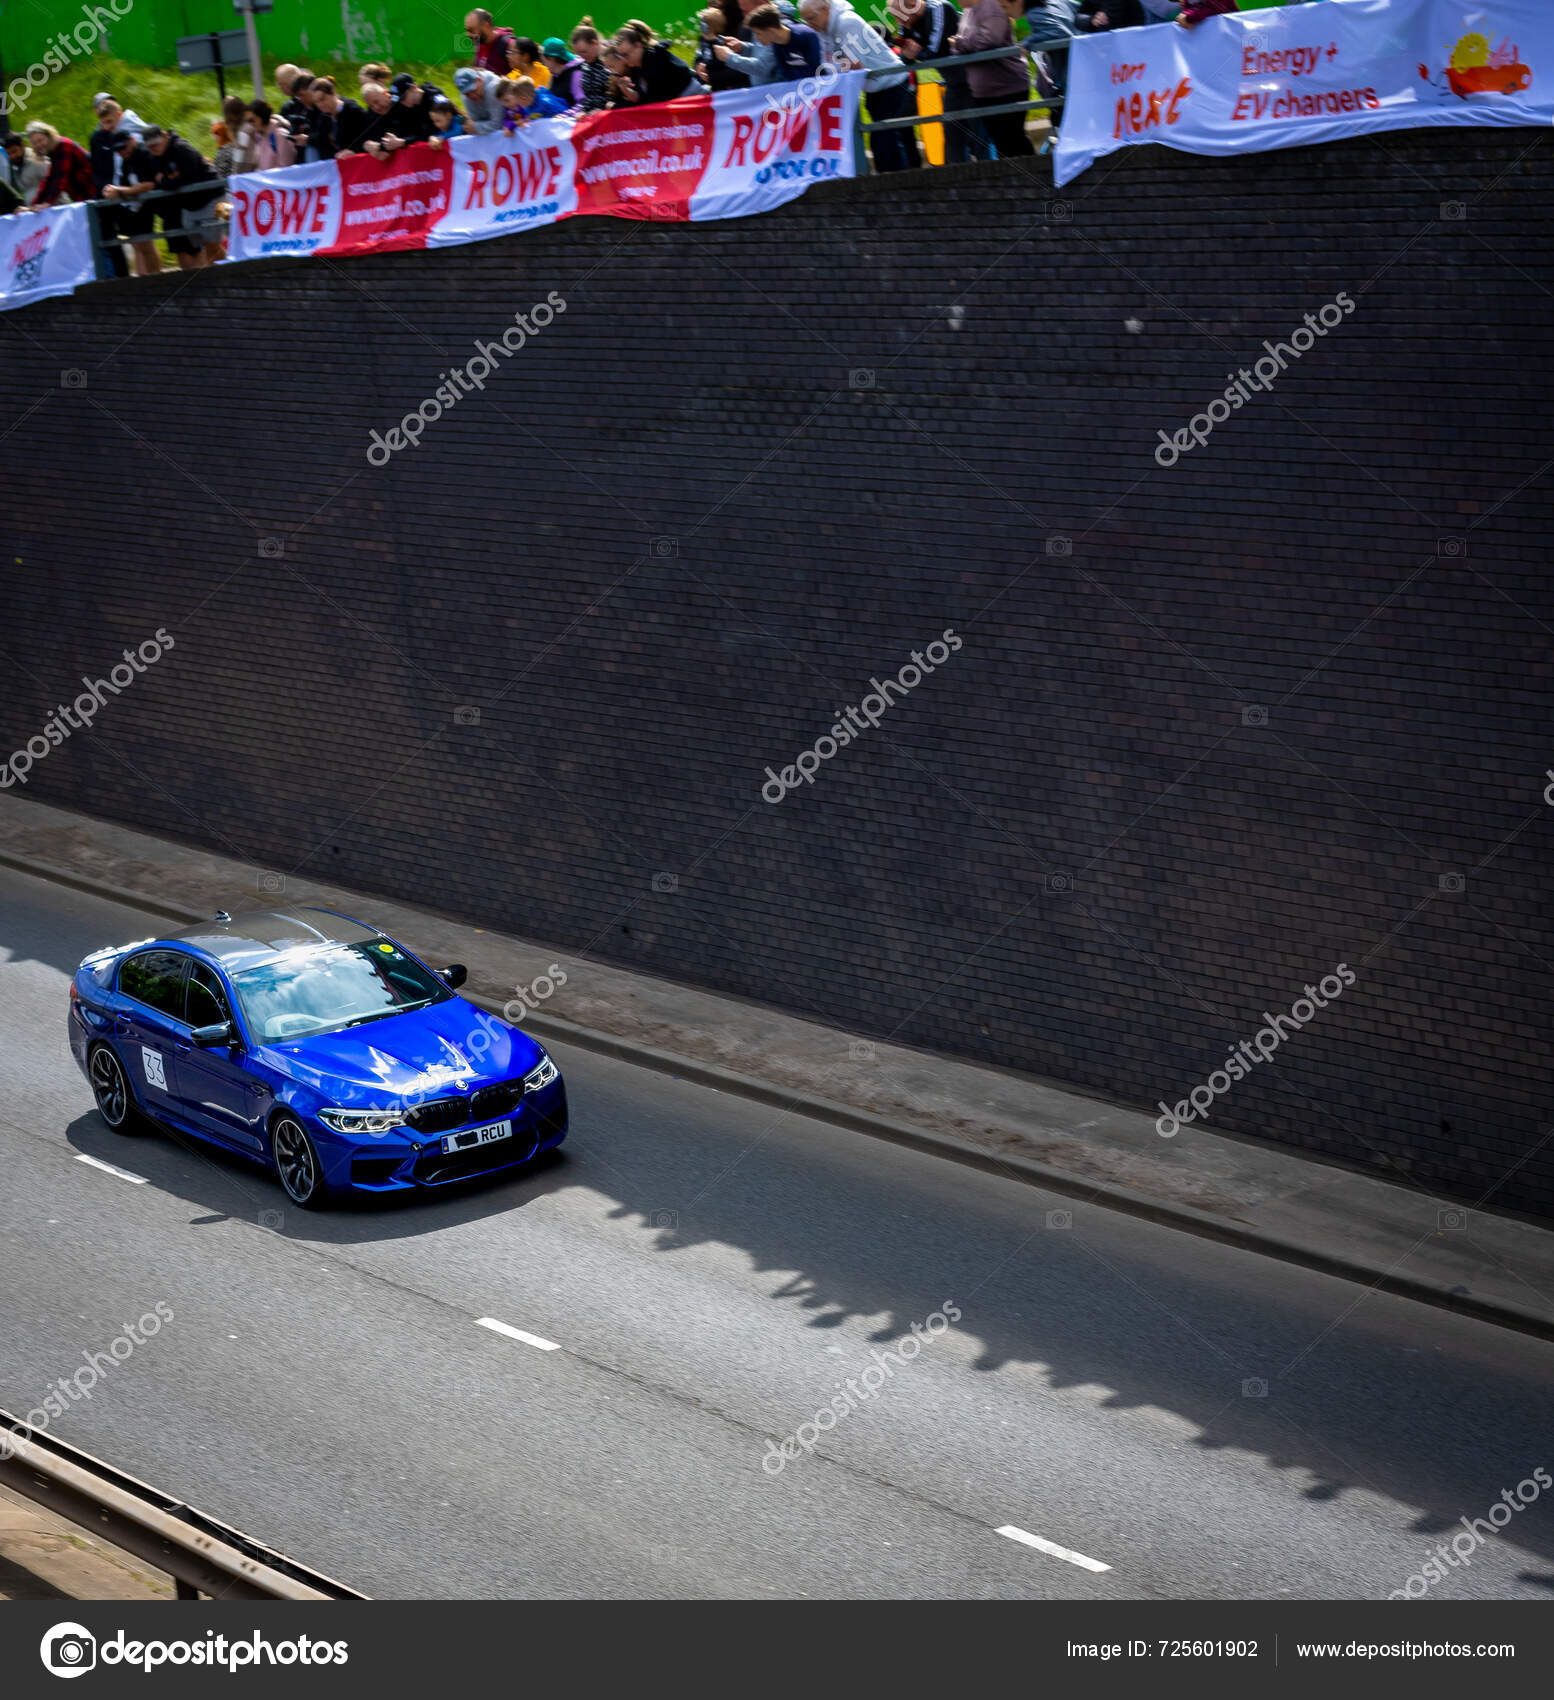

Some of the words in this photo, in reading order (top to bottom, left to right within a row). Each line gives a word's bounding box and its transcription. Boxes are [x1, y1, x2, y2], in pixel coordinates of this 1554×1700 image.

[1241, 46, 1322, 76] Energy
[1111, 77, 1193, 139] next
[1231, 92, 1270, 120] EV
[1271, 87, 1380, 119] chargers
[463, 146, 562, 211] ROWE
[231, 185, 331, 236] ROWE
[143, 1052, 165, 1085] 33
[481, 1124, 505, 1142] RCU
